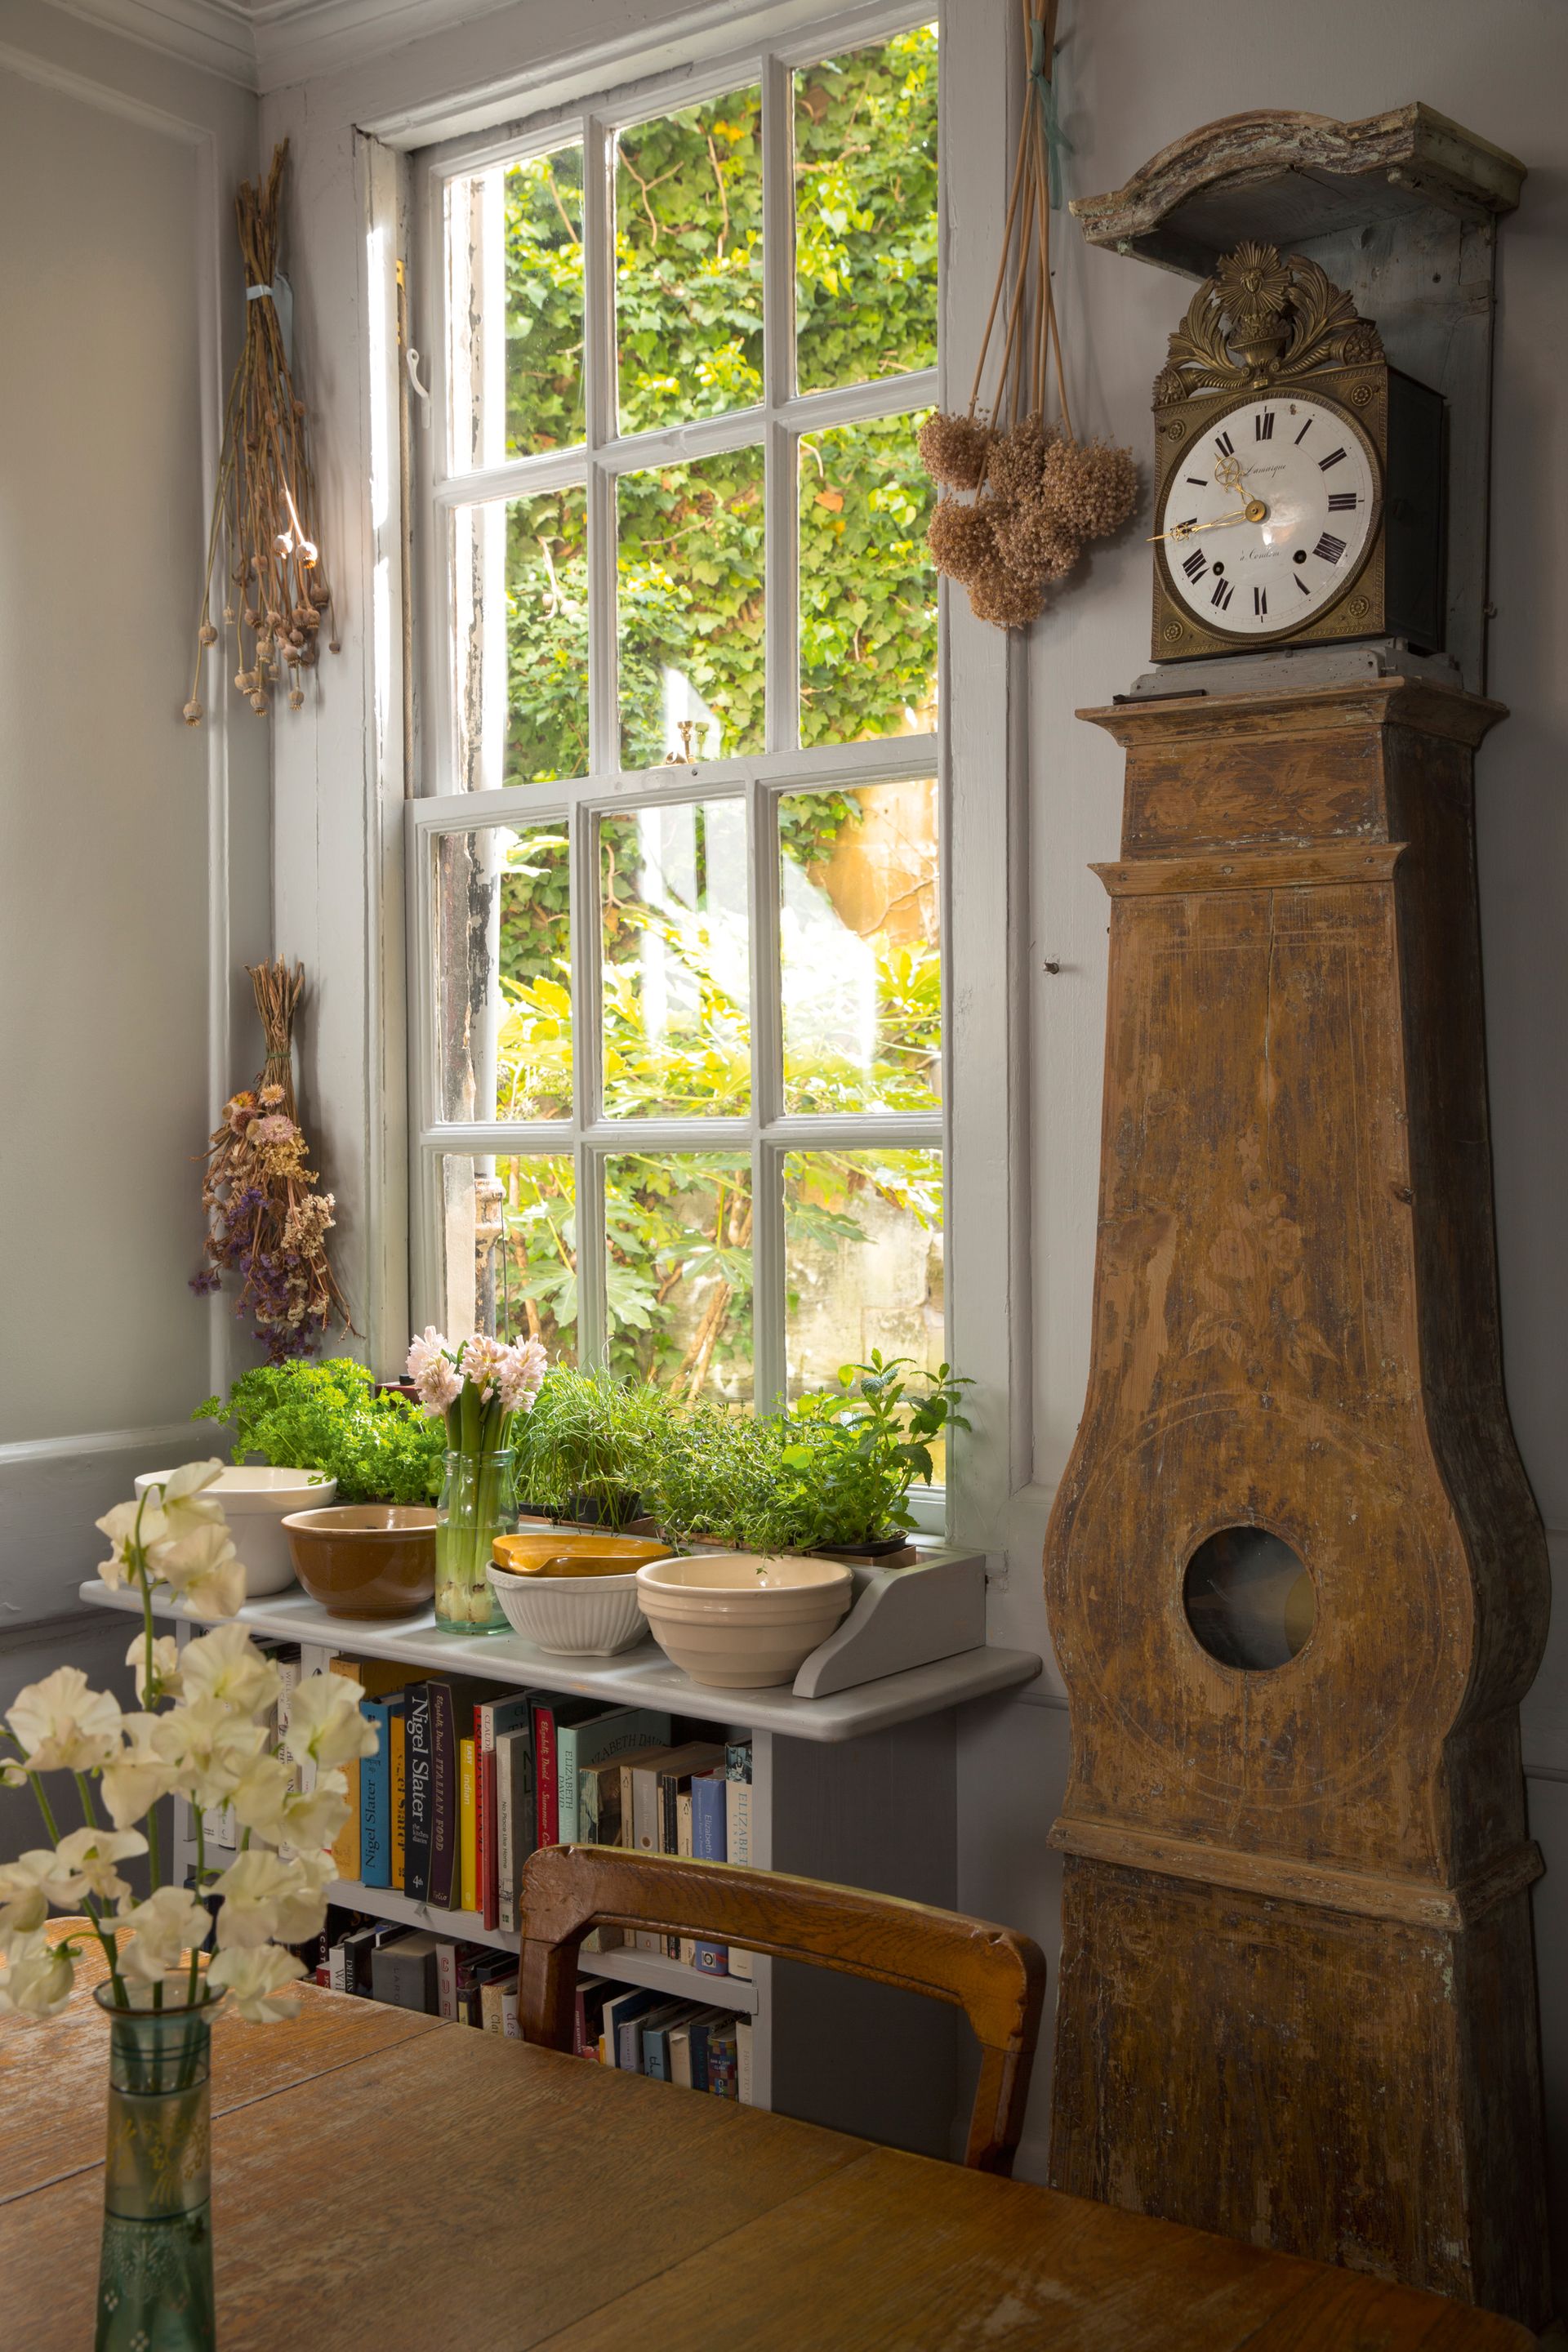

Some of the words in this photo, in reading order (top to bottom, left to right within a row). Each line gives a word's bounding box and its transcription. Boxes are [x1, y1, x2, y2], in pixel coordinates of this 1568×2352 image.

[407, 1696, 429, 1753] Nigel
[435, 1729, 444, 1751] David
[541, 1721, 550, 1755] Elizabeth
[435, 1757, 444, 1815] ITALIAN
[541, 1757, 550, 1780] David
[564, 1750, 573, 1810] ELIZABETH
[365, 1780, 376, 1824] Slater
[412, 1756, 430, 1822] Slater
[464, 1774, 473, 1805] indian
[501, 1801, 508, 1811] No
[541, 1791, 550, 1829] Summer
[366, 1829, 380, 1869] Nigel
[435, 1818, 444, 1851] FOOD
[704, 1814, 713, 1854] Elizabeth
